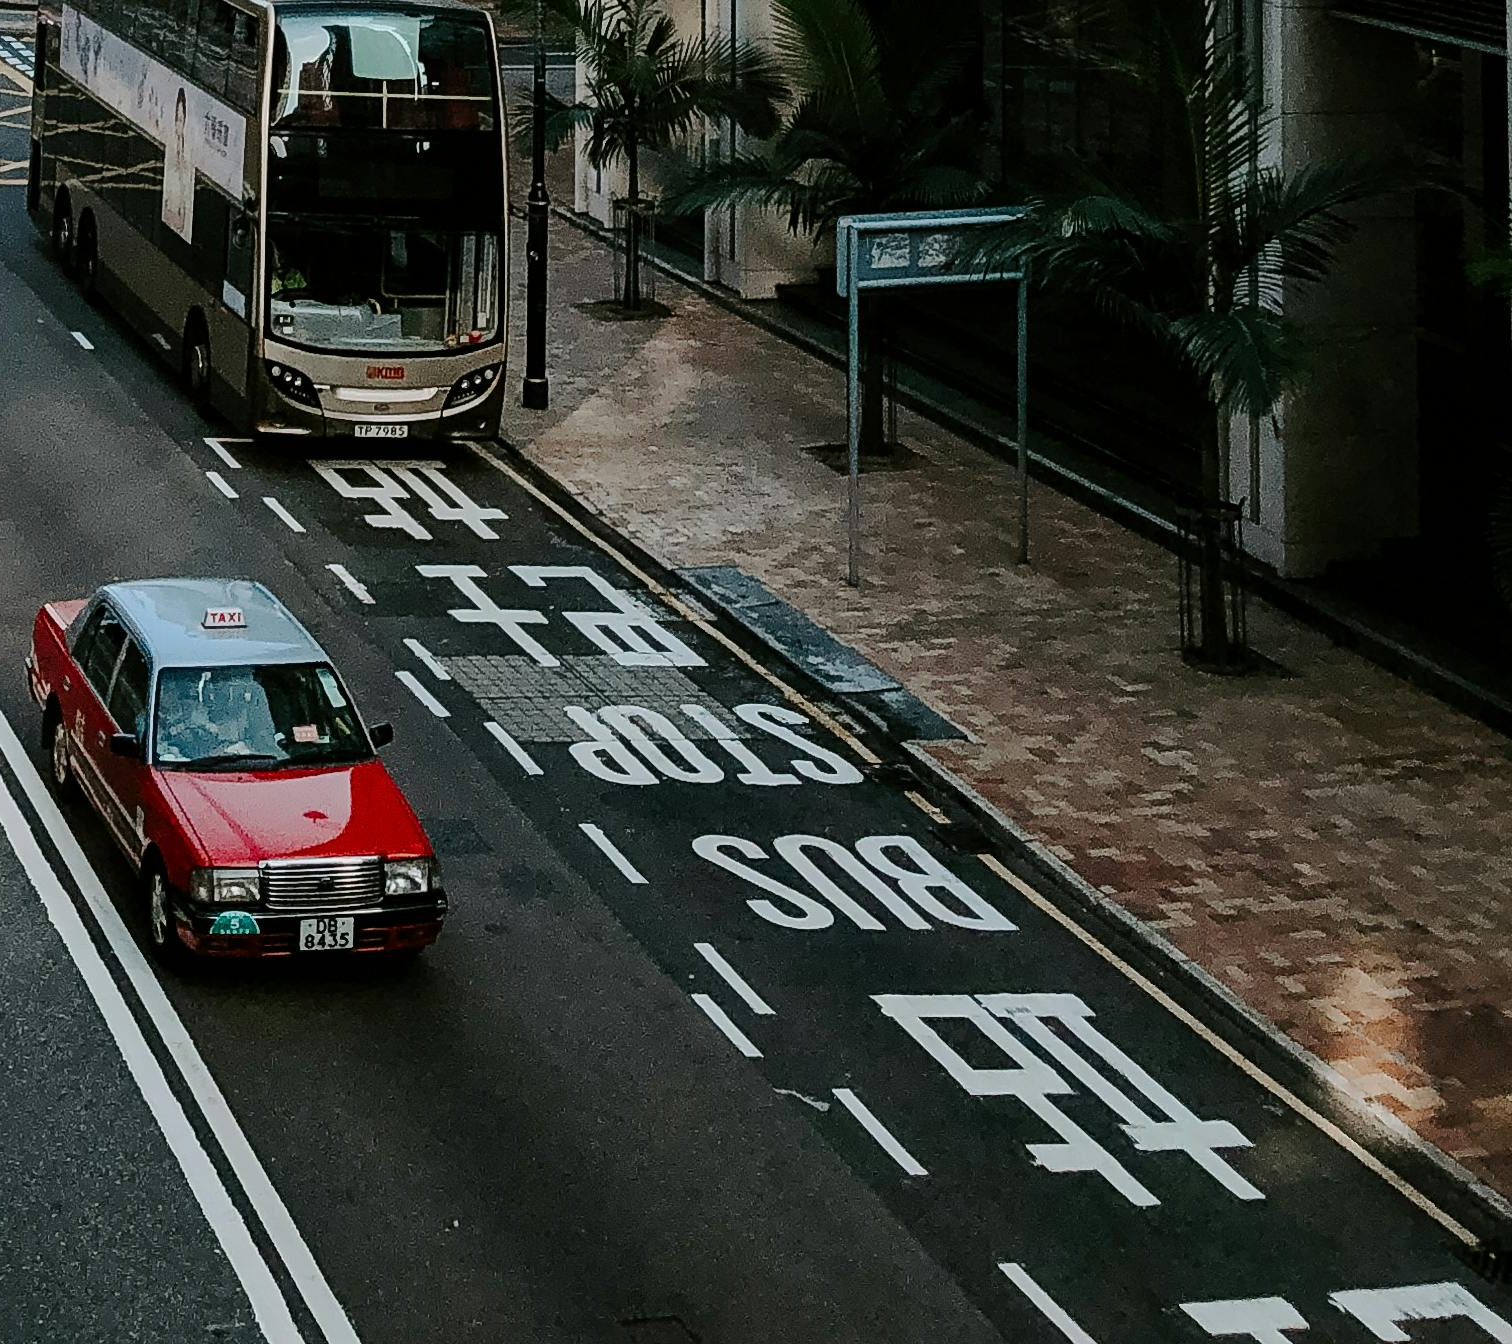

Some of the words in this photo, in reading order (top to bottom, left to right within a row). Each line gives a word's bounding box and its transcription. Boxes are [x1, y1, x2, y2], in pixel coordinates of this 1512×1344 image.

[358, 426, 373, 436] TP
[376, 426, 406, 437] 7985
[306, 459, 509, 540] 站
[210, 612, 241, 623] TAXI
[414, 564, 708, 667] 巴士
[563, 703, 865, 786] STOP
[691, 833, 1020, 932] BUS
[304, 932, 350, 950] 8435
[317, 918, 338, 933] DB
[868, 992, 1266, 1208] 站
